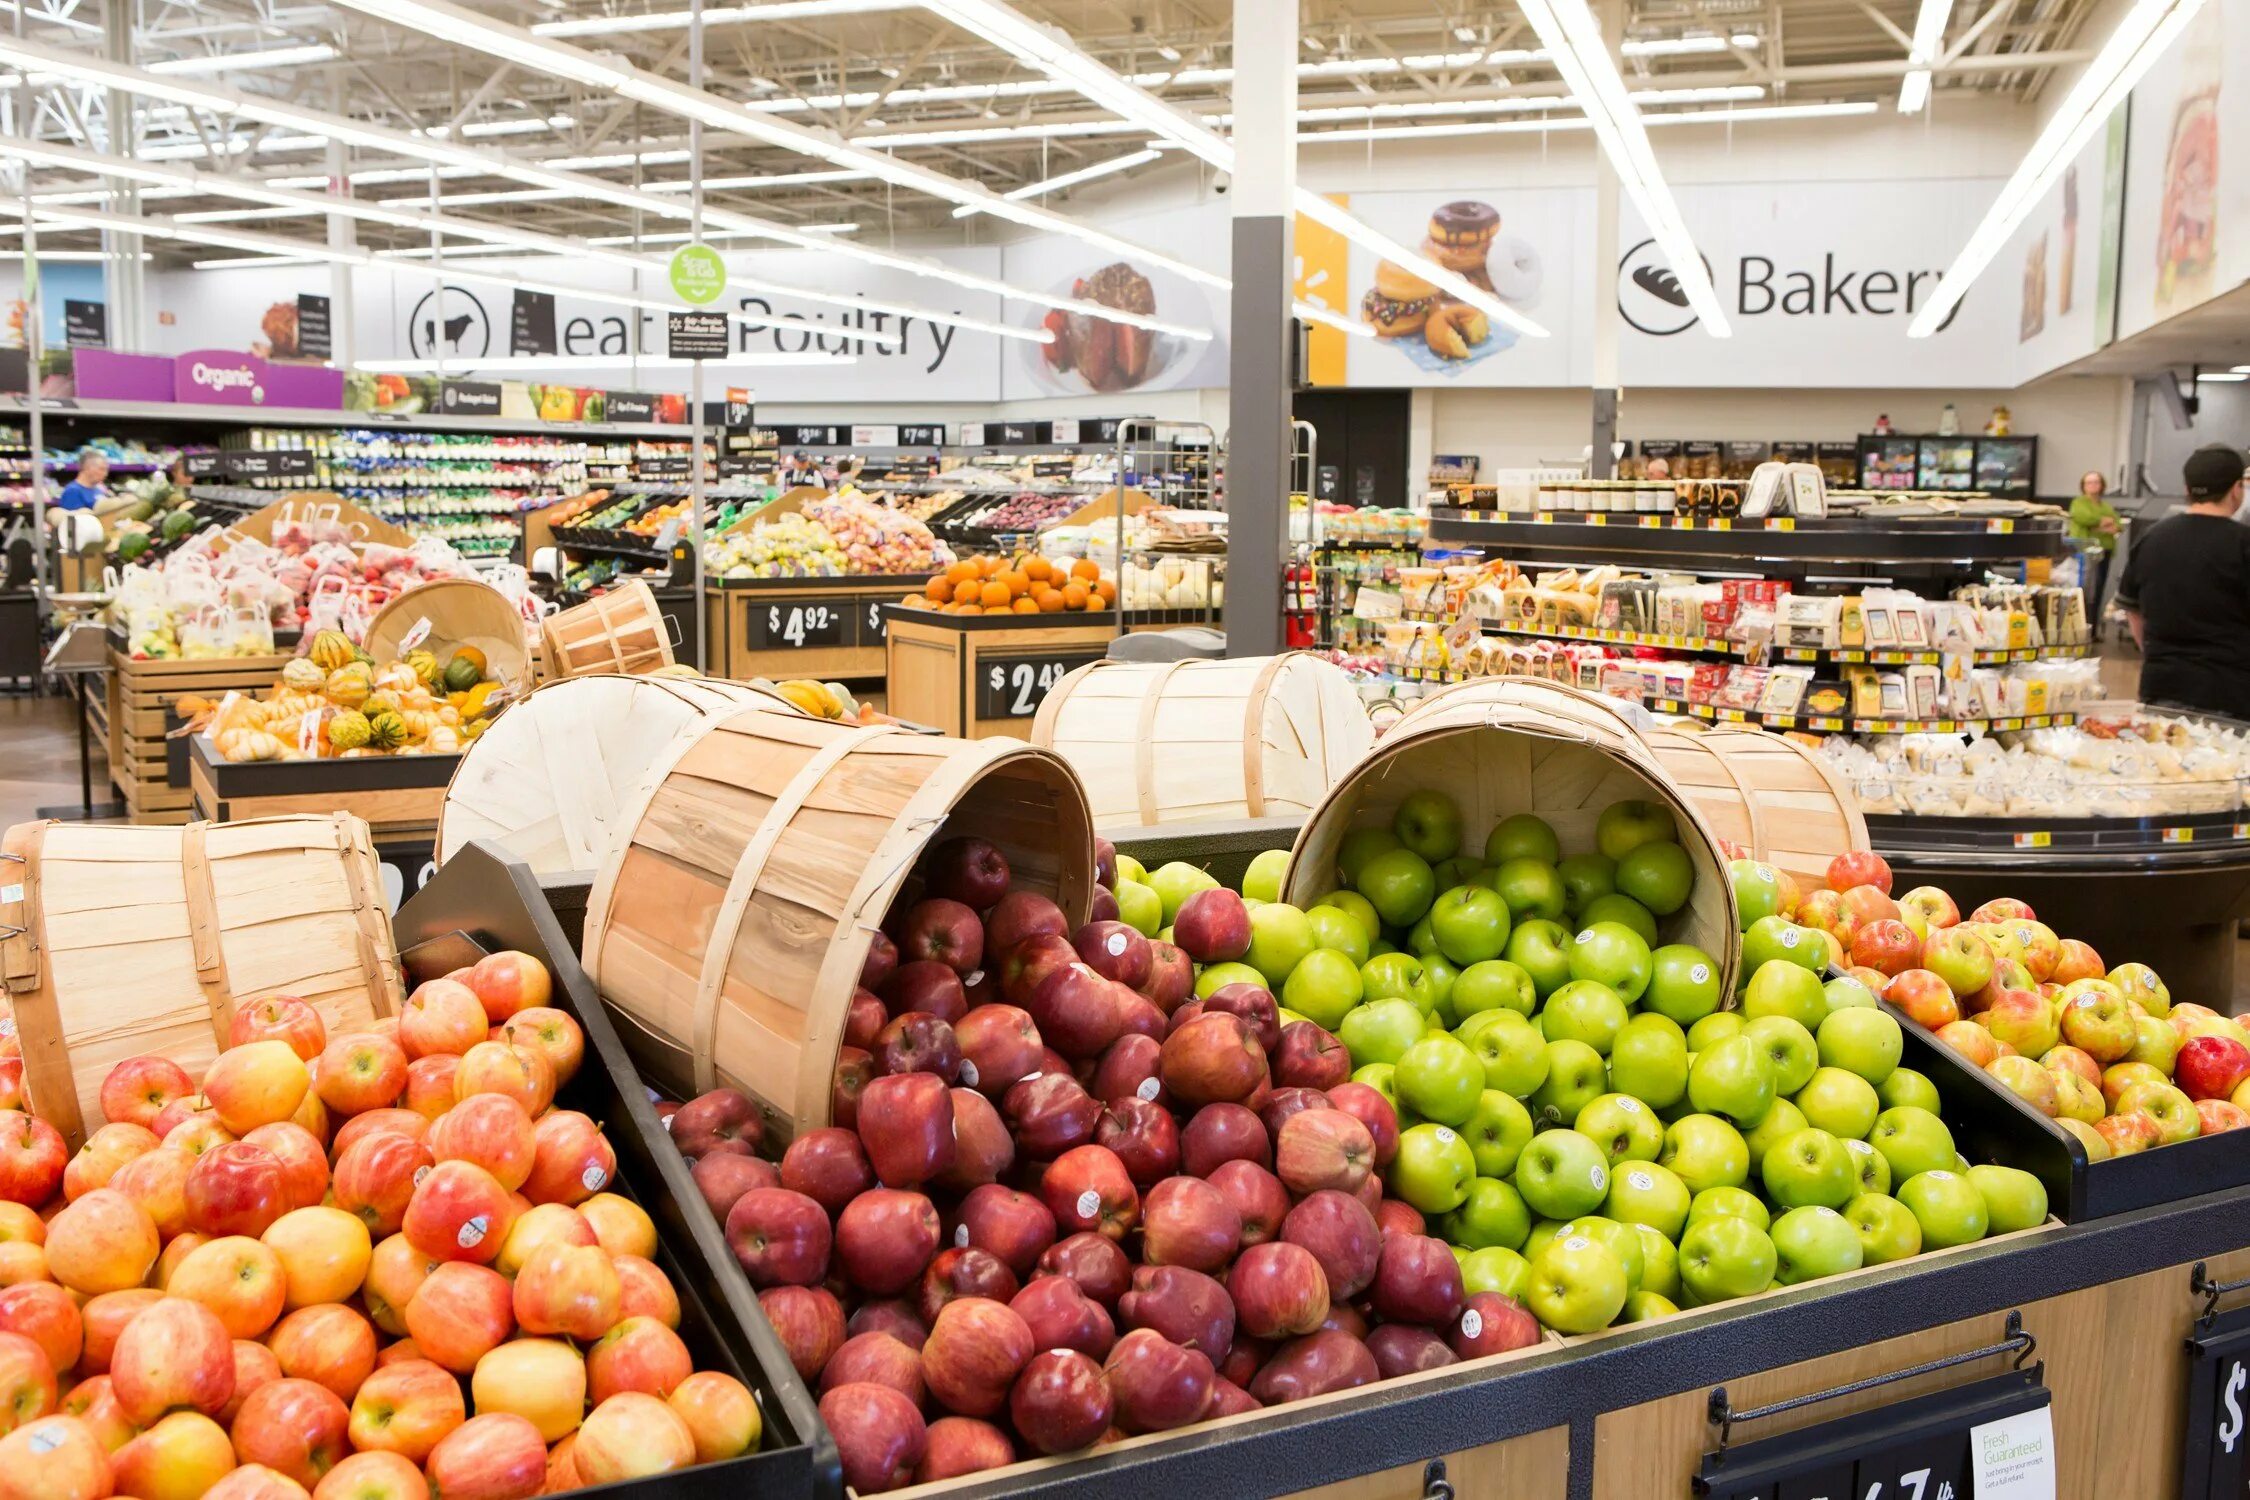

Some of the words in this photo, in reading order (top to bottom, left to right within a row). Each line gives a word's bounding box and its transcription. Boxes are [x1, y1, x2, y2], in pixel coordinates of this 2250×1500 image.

[740, 293, 962, 374] Poultry
[192, 362, 255, 392] Organic
[1984, 1430, 2009, 1450] Fresh
[1984, 1436, 2042, 1465] Guaranteed
[1985, 1470, 1994, 1478] Just
[2015, 1462, 2026, 1471] your
[1985, 1480, 1994, 1488] Get
[1999, 1476, 2007, 1485] full
